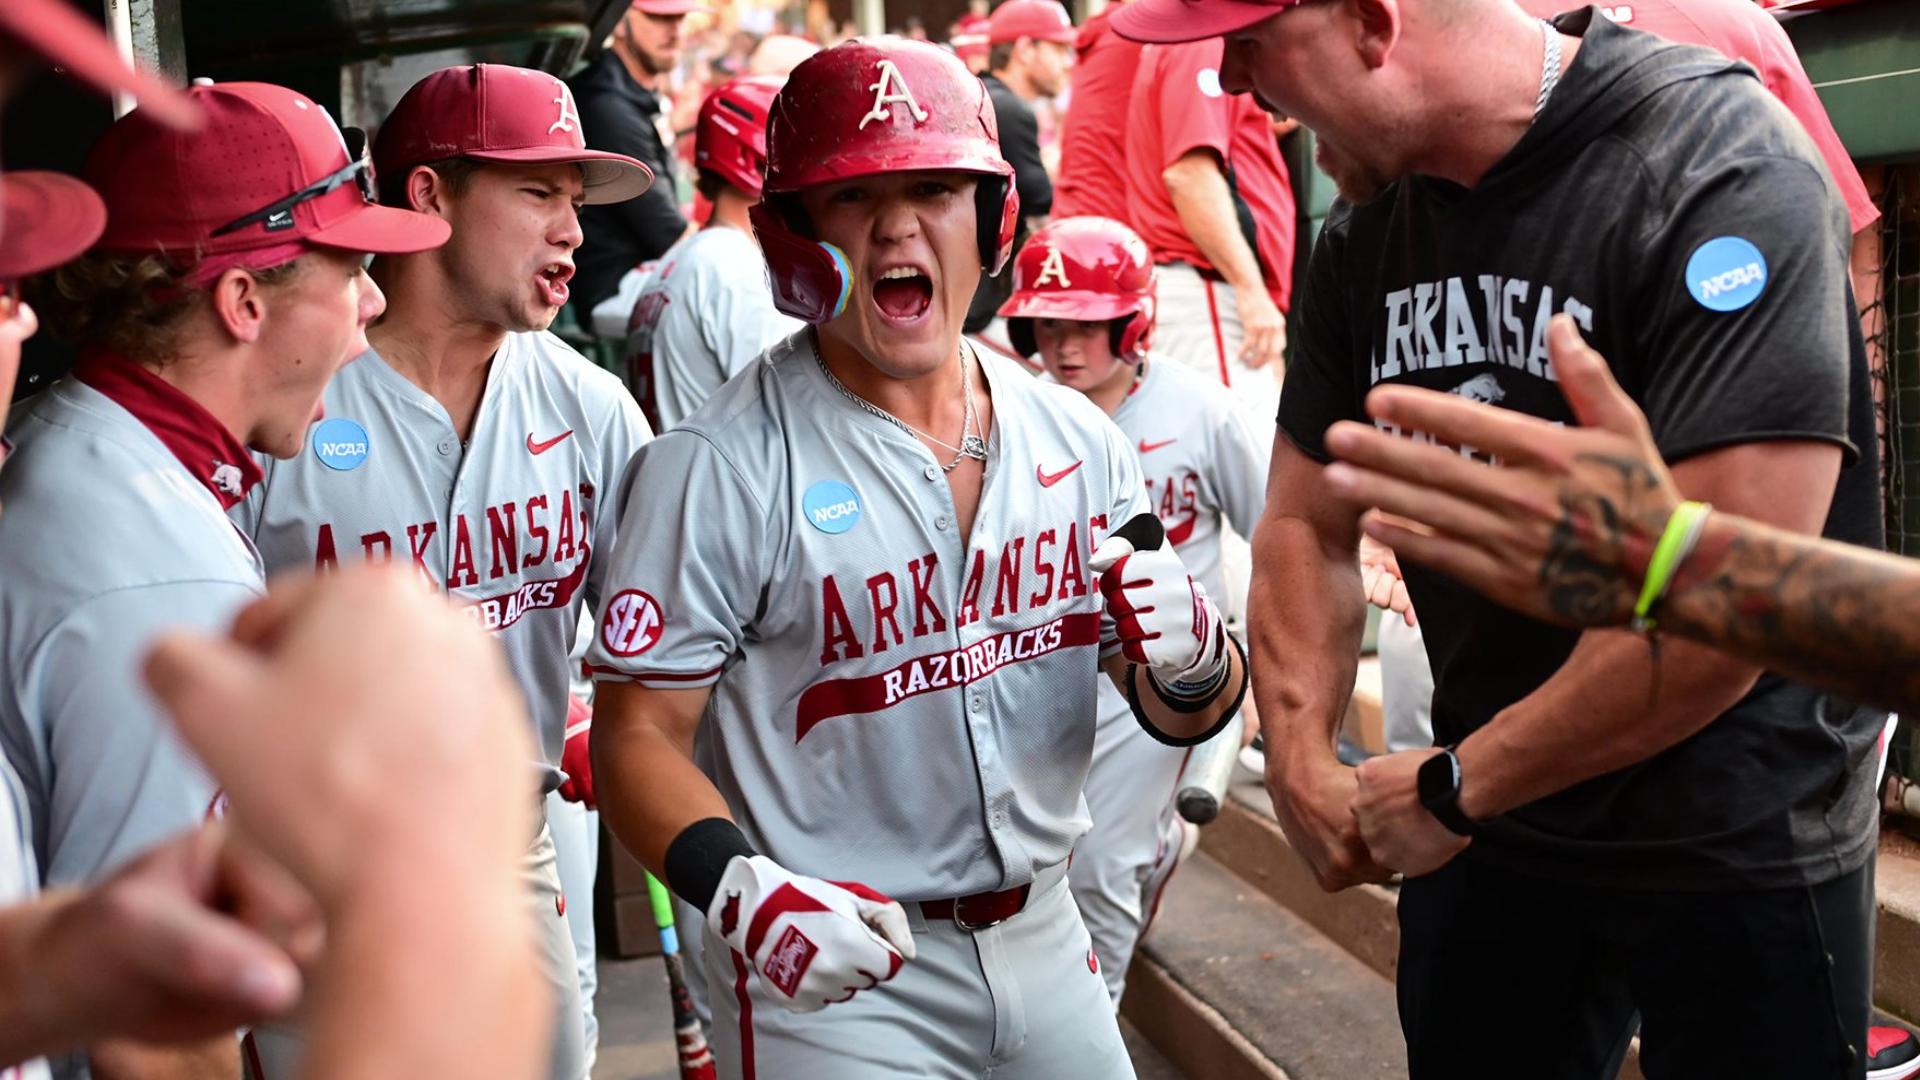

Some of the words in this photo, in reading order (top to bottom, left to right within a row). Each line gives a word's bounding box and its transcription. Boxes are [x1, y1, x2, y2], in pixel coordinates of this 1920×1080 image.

[548, 80, 587, 149] A
[859, 60, 928, 131] A
[1033, 247, 1072, 289] A
[1700, 262, 1764, 299] NCAA
[1371, 274, 1593, 386] RKANSA
[322, 442, 366, 456] NCAA
[813, 500, 859, 523] NCAA
[605, 594, 660, 653] SEC
[883, 618, 1063, 704] RAZORBACKS
